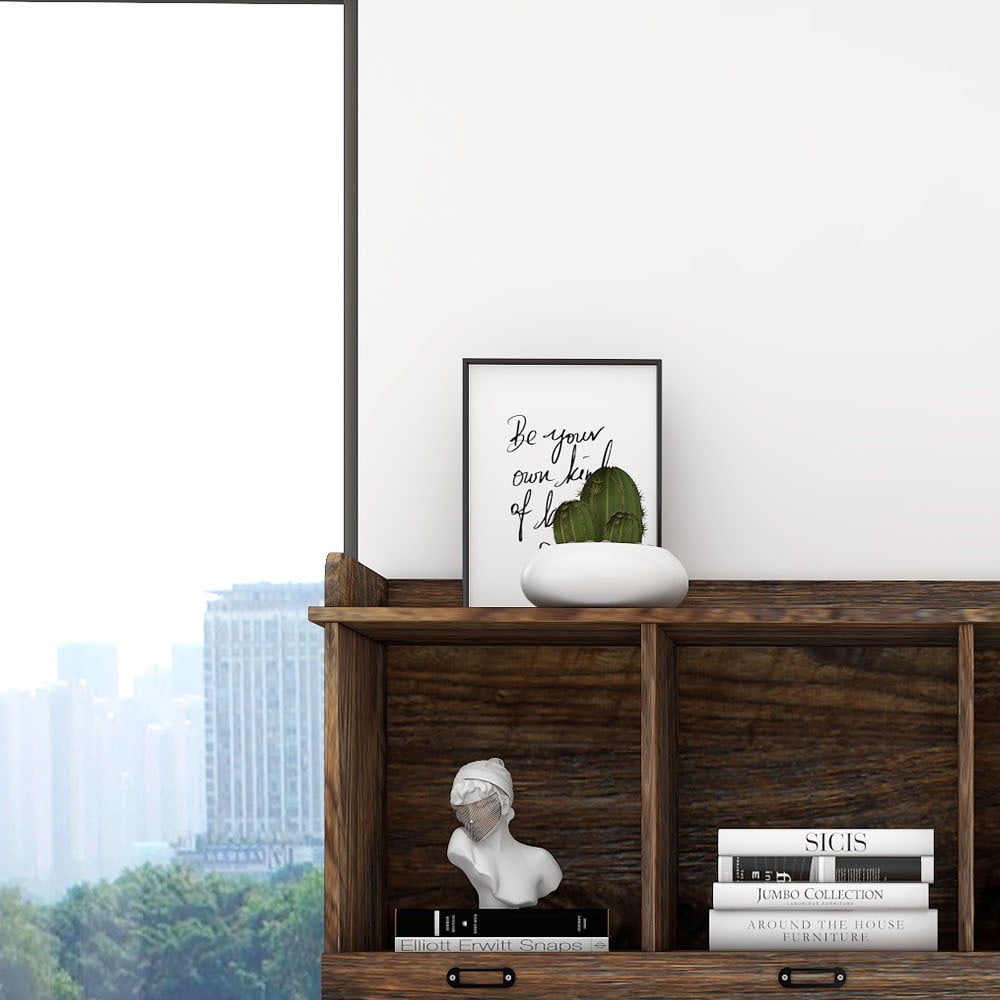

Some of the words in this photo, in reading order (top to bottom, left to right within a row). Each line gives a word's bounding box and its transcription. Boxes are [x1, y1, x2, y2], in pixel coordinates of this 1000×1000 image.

[506, 414, 537, 453] Be
[543, 426, 605, 464] your
[512, 469, 555, 487] own
[510, 489, 532, 542] of
[805, 832, 867, 852] SICIS
[747, 919, 812, 930] AROUND
[817, 919, 848, 930] THE
[854, 919, 905, 930] HOUSE
[400, 939, 450, 952] Elliott
[459, 939, 512, 952] Erwitt
[519, 939, 583, 952] Snaps
[783, 932, 870, 943] FURNITURE
